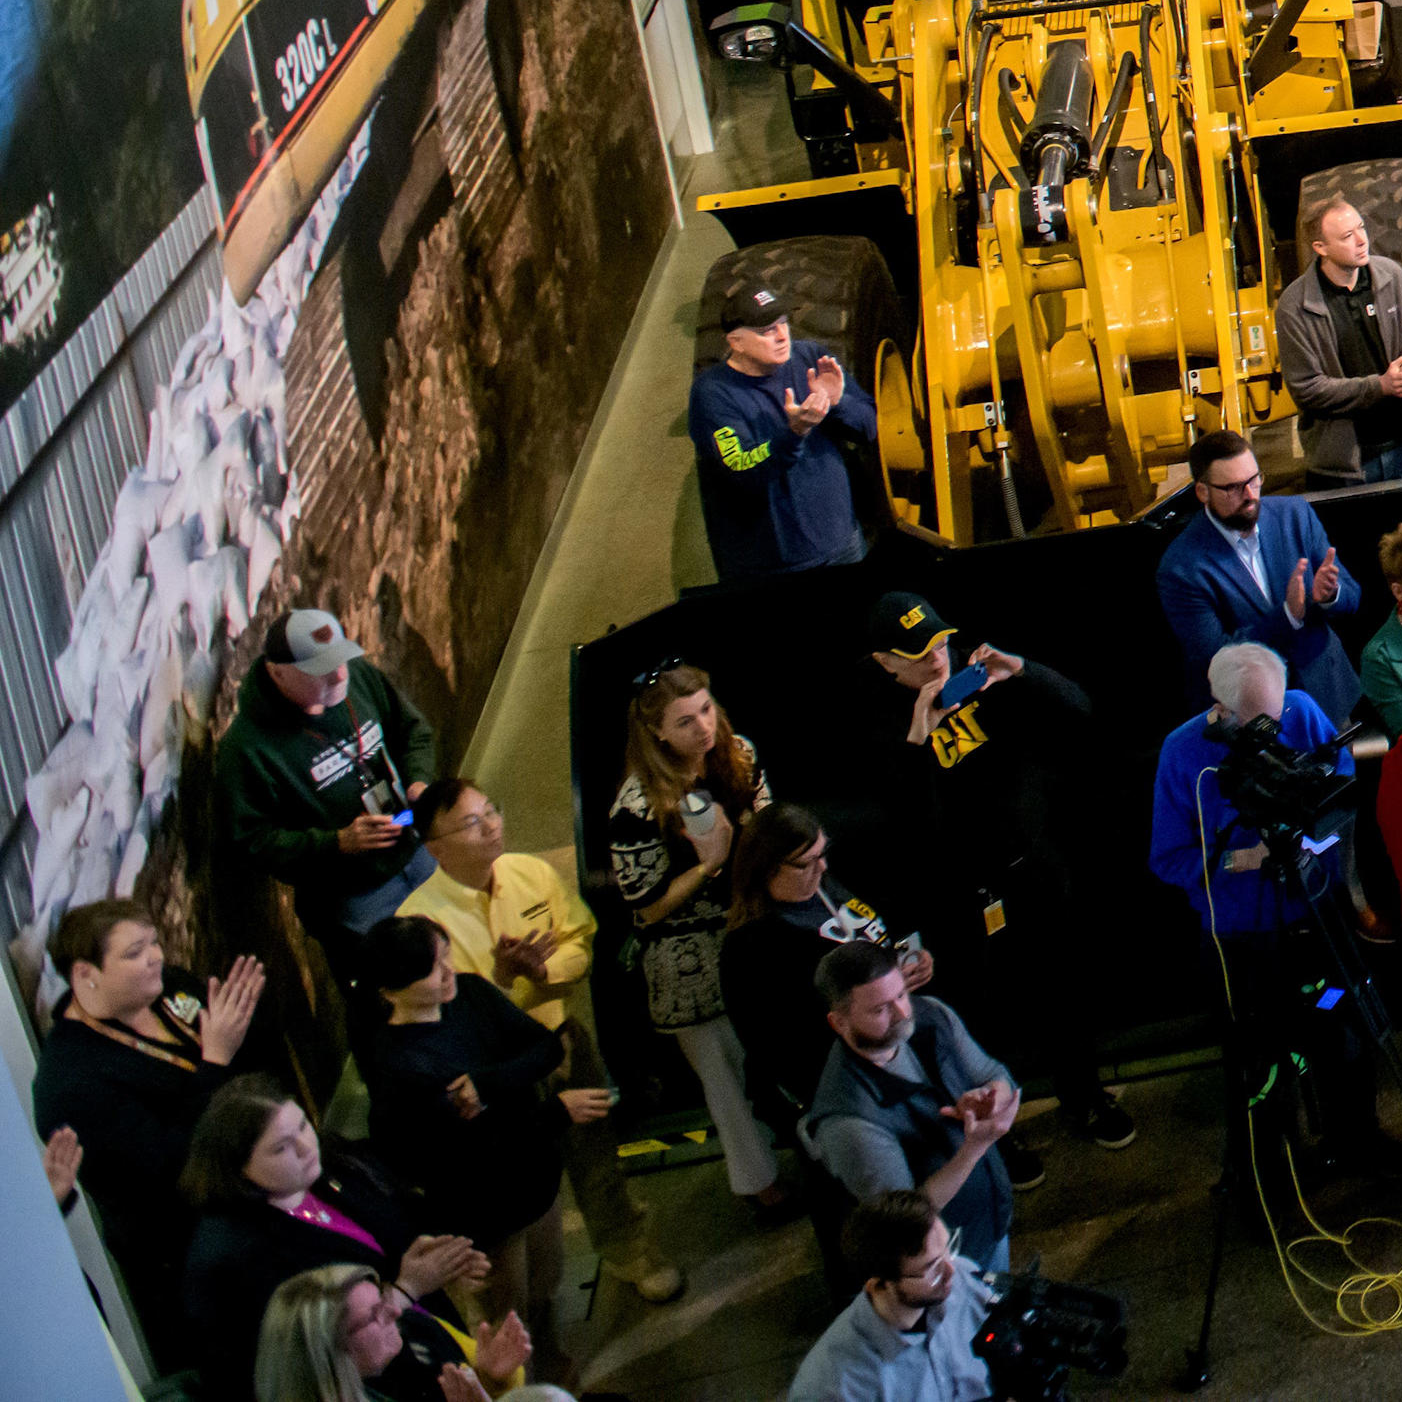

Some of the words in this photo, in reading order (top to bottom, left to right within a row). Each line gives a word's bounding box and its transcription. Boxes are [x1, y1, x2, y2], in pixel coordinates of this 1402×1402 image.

[275, 18, 326, 112] 320C
[899, 605, 927, 630] CAT
[931, 700, 989, 768] CAT
